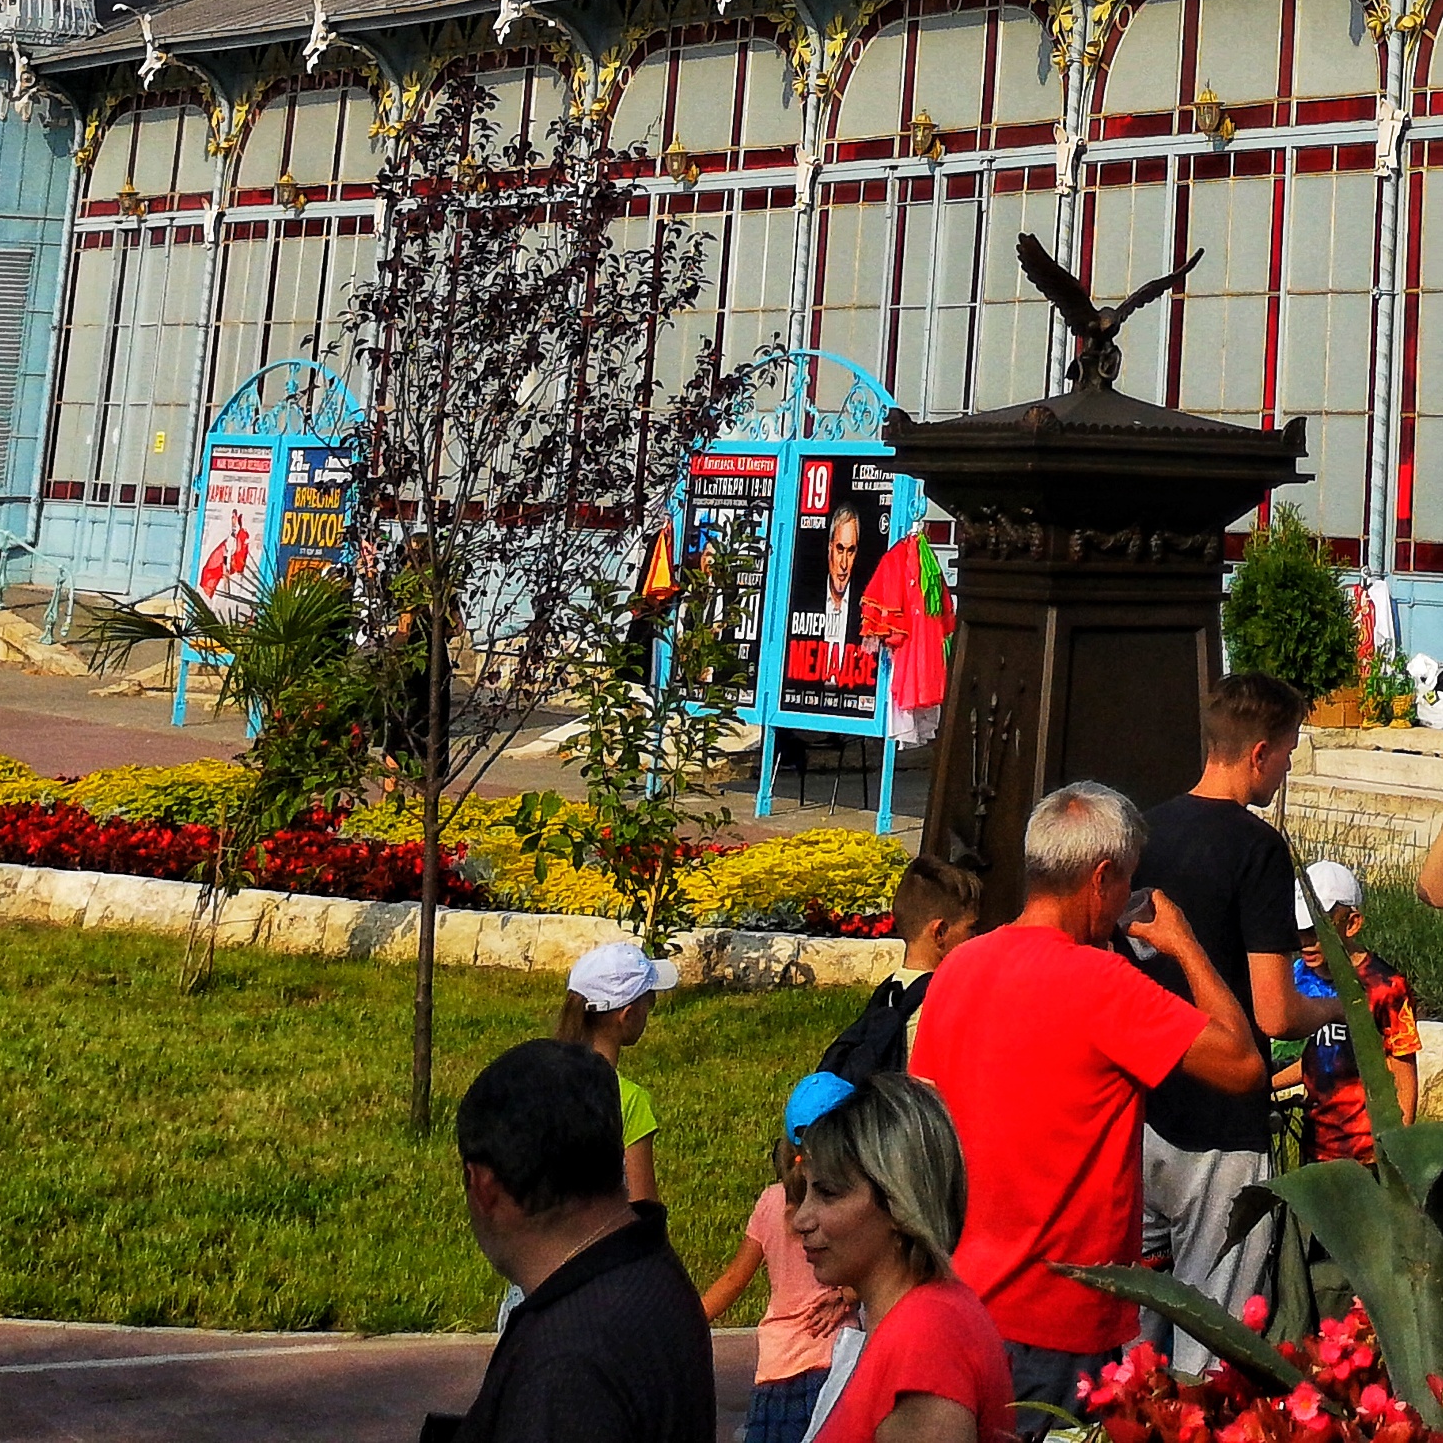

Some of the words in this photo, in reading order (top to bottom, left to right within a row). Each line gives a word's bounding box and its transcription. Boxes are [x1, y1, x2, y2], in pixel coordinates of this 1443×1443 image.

[294, 486, 341, 509] ВЯЧЕСЛАВ
[751, 477, 773, 497] 19:00
[806, 465, 828, 509] 19
[791, 611, 841, 637] ВАЛЕРИЙ
[787, 639, 877, 689] МЕЛАДЗЕ
